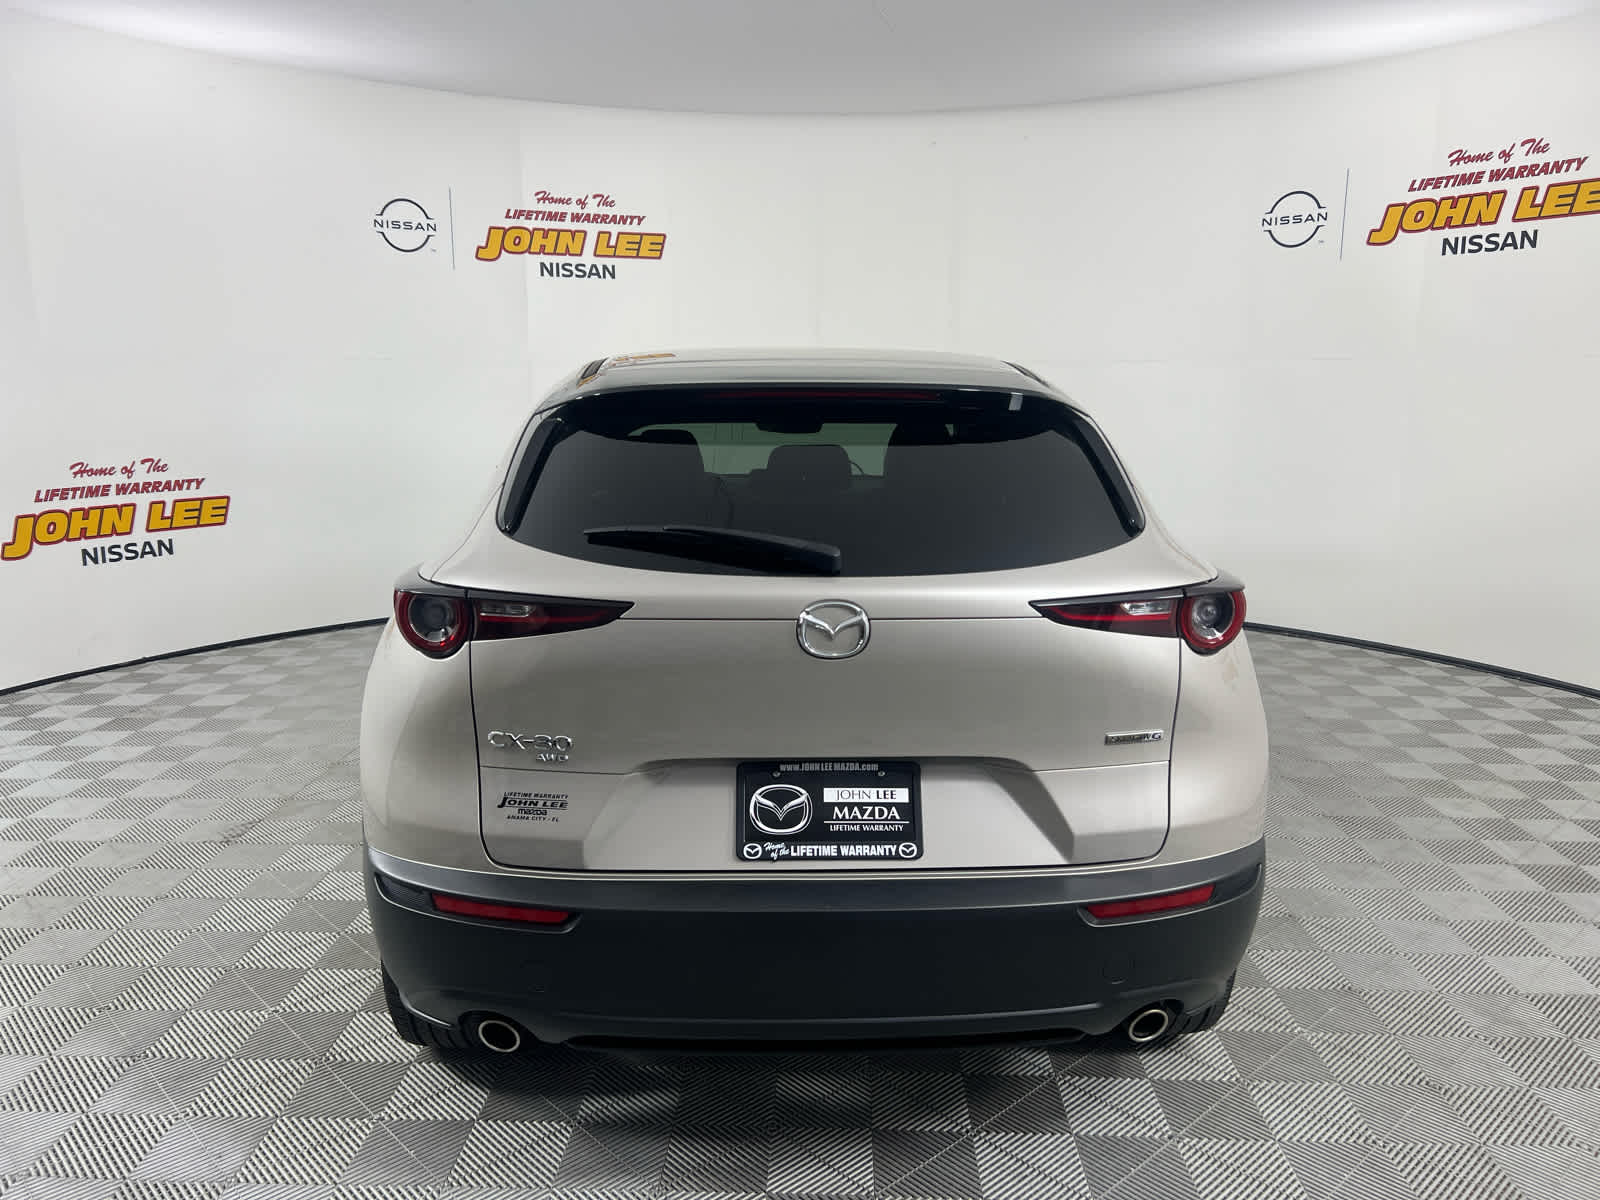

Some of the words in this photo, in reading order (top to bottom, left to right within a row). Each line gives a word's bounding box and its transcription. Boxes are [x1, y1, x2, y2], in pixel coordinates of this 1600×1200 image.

[1448, 149, 1494, 167] Home
[1498, 143, 1516, 164] of
[1520, 138, 1551, 156] The
[1408, 170, 1485, 192] LIFETIME
[1488, 156, 1589, 184] WARRANTY
[534, 190, 572, 207] Home
[575, 194, 589, 208] of
[592, 193, 616, 208] The
[373, 218, 437, 232] NISSAN
[505, 208, 569, 223] LIFETIME
[571, 211, 646, 226] WARRANTY
[1261, 212, 1328, 227] NISSAN
[1366, 189, 1508, 246] JOHN
[475, 226, 588, 262] JOHN
[594, 231, 666, 260] LEE
[1441, 230, 1539, 256] NISSAN
[539, 262, 616, 280] NISSAN
[69, 461, 116, 479] Home
[120, 460, 136, 479] of
[140, 458, 169, 474] The
[34, 484, 112, 503] LIFETIME
[115, 478, 205, 496] WARRANTY
[1, 503, 136, 561] JOHN
[146, 496, 231, 533] LEE
[81, 538, 175, 566] NISSAN
[487, 730, 572, 752] CX-30
[497, 797, 539, 808] JOHN
[542, 801, 569, 809] LEE
[533, 792, 569, 800] WARRANTY
[836, 789, 872, 801] JOHN
[876, 789, 897, 800] LEE
[832, 806, 901, 820] MAZDA
[829, 824, 861, 832] LIFETIME
[862, 824, 904, 832] WARRANTY
[763, 841, 786, 852] Home
[770, 849, 779, 860] of
[790, 845, 838, 857] LIFETIME
[840, 844, 897, 857] WARRANTY
